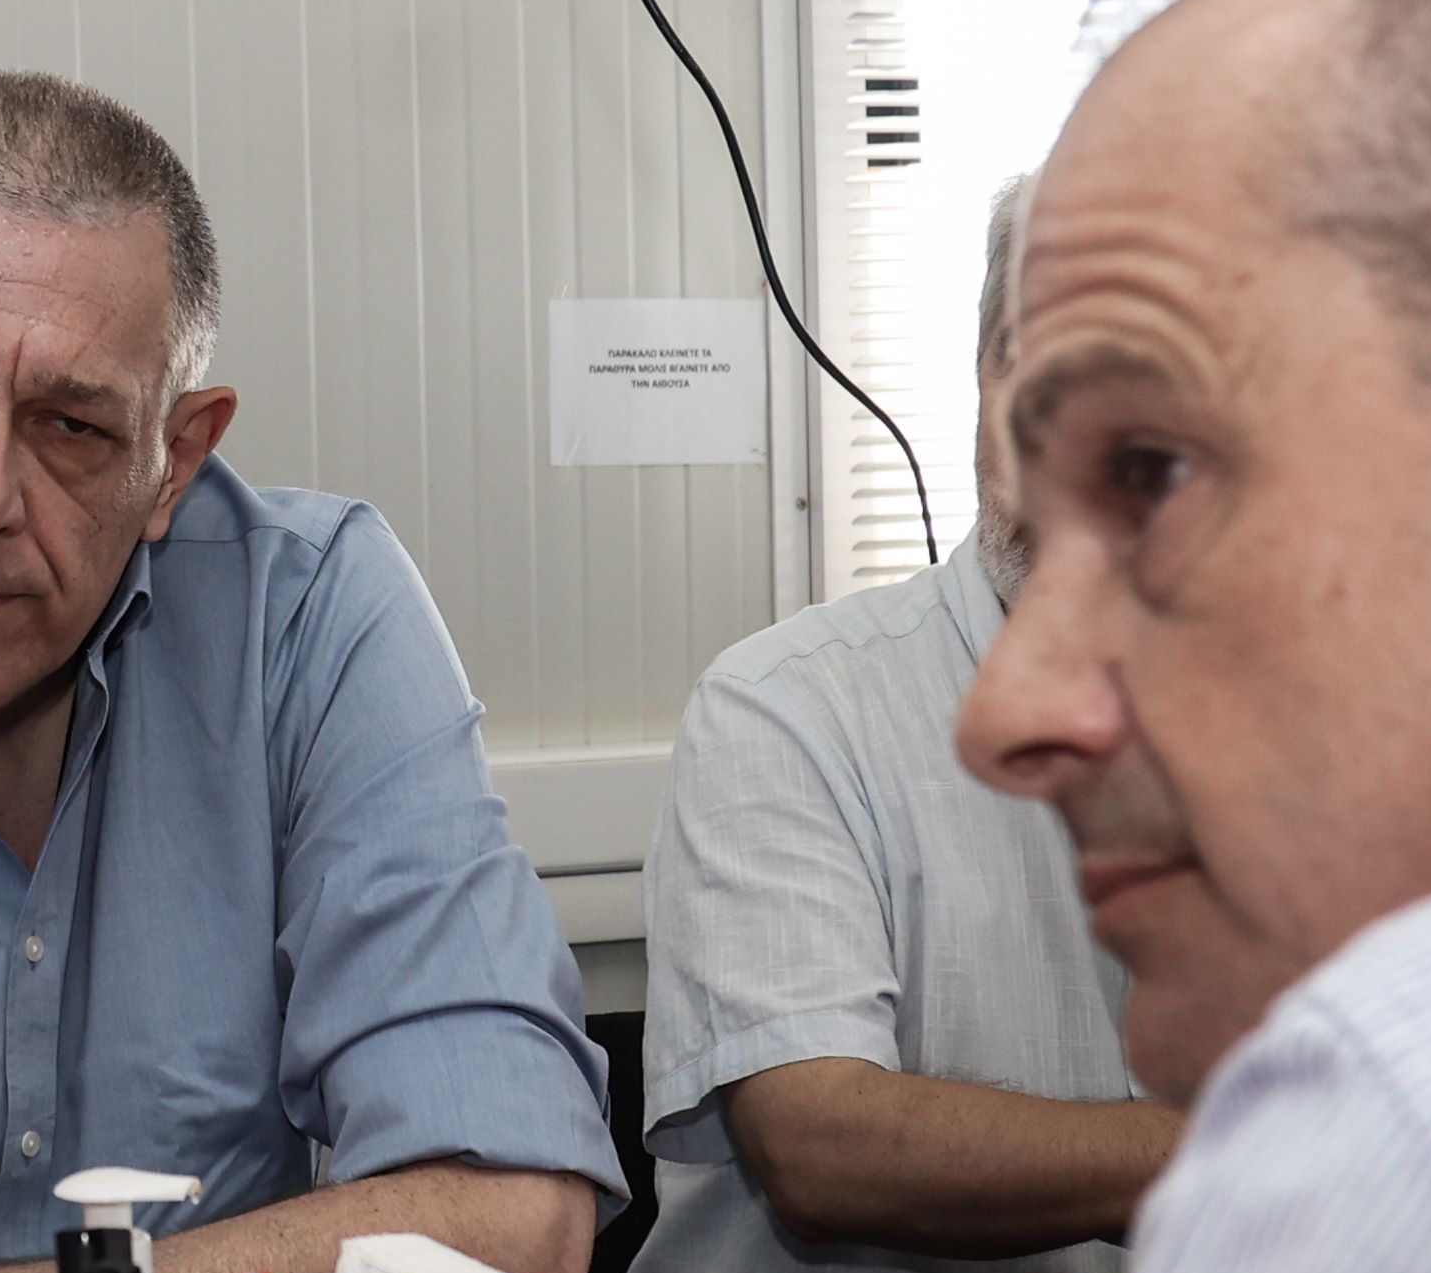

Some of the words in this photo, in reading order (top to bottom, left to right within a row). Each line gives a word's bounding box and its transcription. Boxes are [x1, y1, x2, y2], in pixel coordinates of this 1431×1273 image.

[702, 348, 712, 357] ΤΑ
[589, 364, 636, 374] ΠΑΡΑΘΥΡΑ
[638, 364, 667, 373] ΜΟΛΙΣ
[711, 363, 731, 373] ΑΠΟ
[631, 379, 650, 389] ΤΗΝ
[652, 379, 690, 388] ΑΙΘΟΥΣΑ
